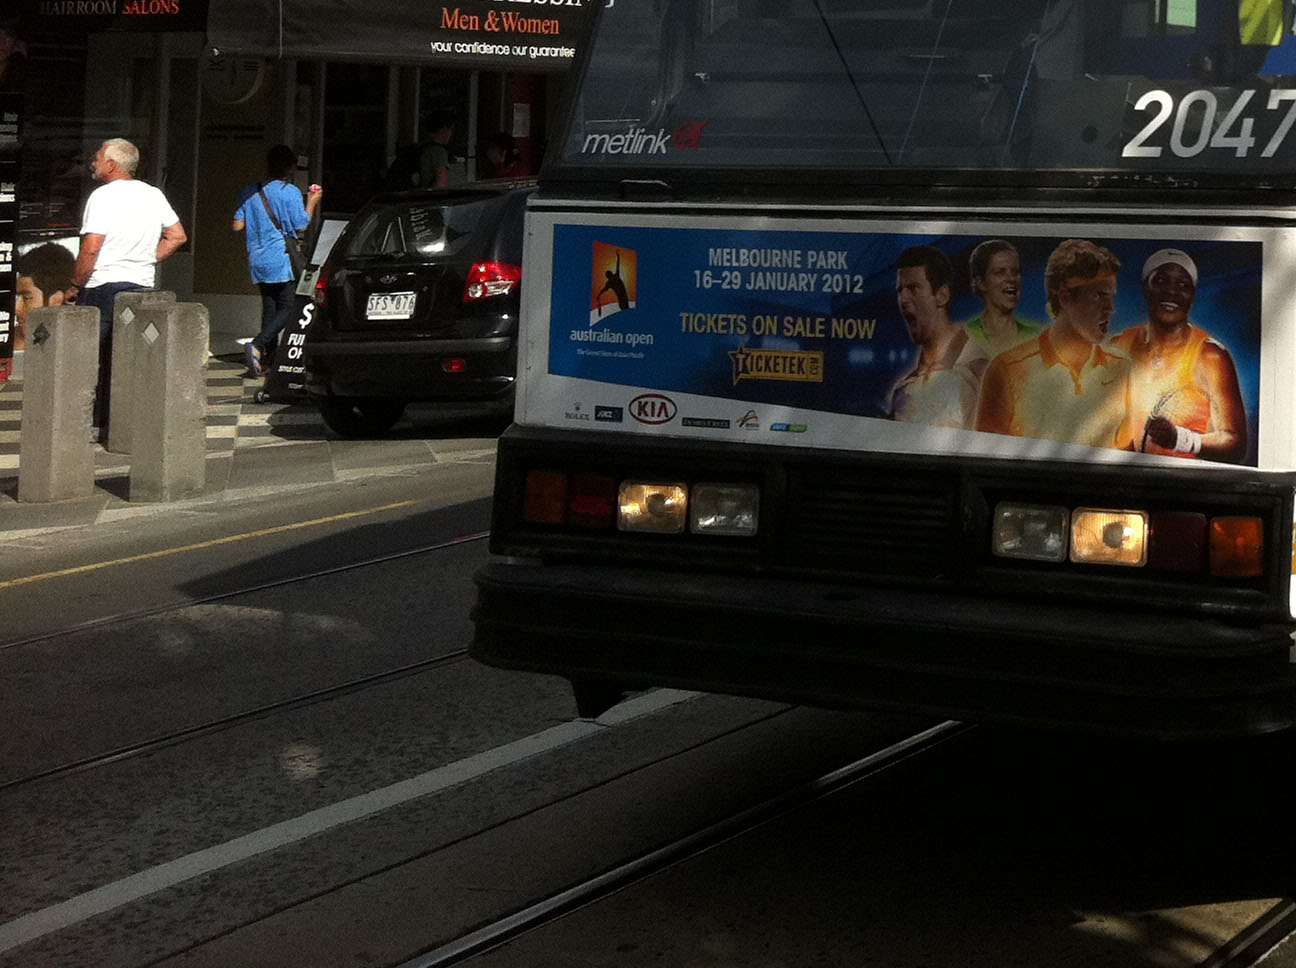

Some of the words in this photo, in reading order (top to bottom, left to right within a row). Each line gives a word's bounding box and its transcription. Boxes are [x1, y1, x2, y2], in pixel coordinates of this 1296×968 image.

[120, 0, 181, 16] SALONS
[440, 7, 481, 31] Men
[500, 10, 561, 35] Women
[430, 40, 453, 54] your
[454, 41, 511, 57] confidence
[581, 128, 672, 154] metlink
[708, 247, 802, 269] MELBOURNE
[806, 249, 849, 271] PARK
[745, 271, 818, 293] JANUARY
[821, 274, 864, 294] 2012
[679, 311, 748, 335] TICKETS
[751, 314, 779, 336] ON
[782, 315, 826, 339] SALE
[831, 318, 877, 340] NOW
[570, 327, 624, 345] australian
[624, 331, 655, 348] open
[735, 351, 806, 375] TICKETEK
[637, 400, 670, 418] KIA
